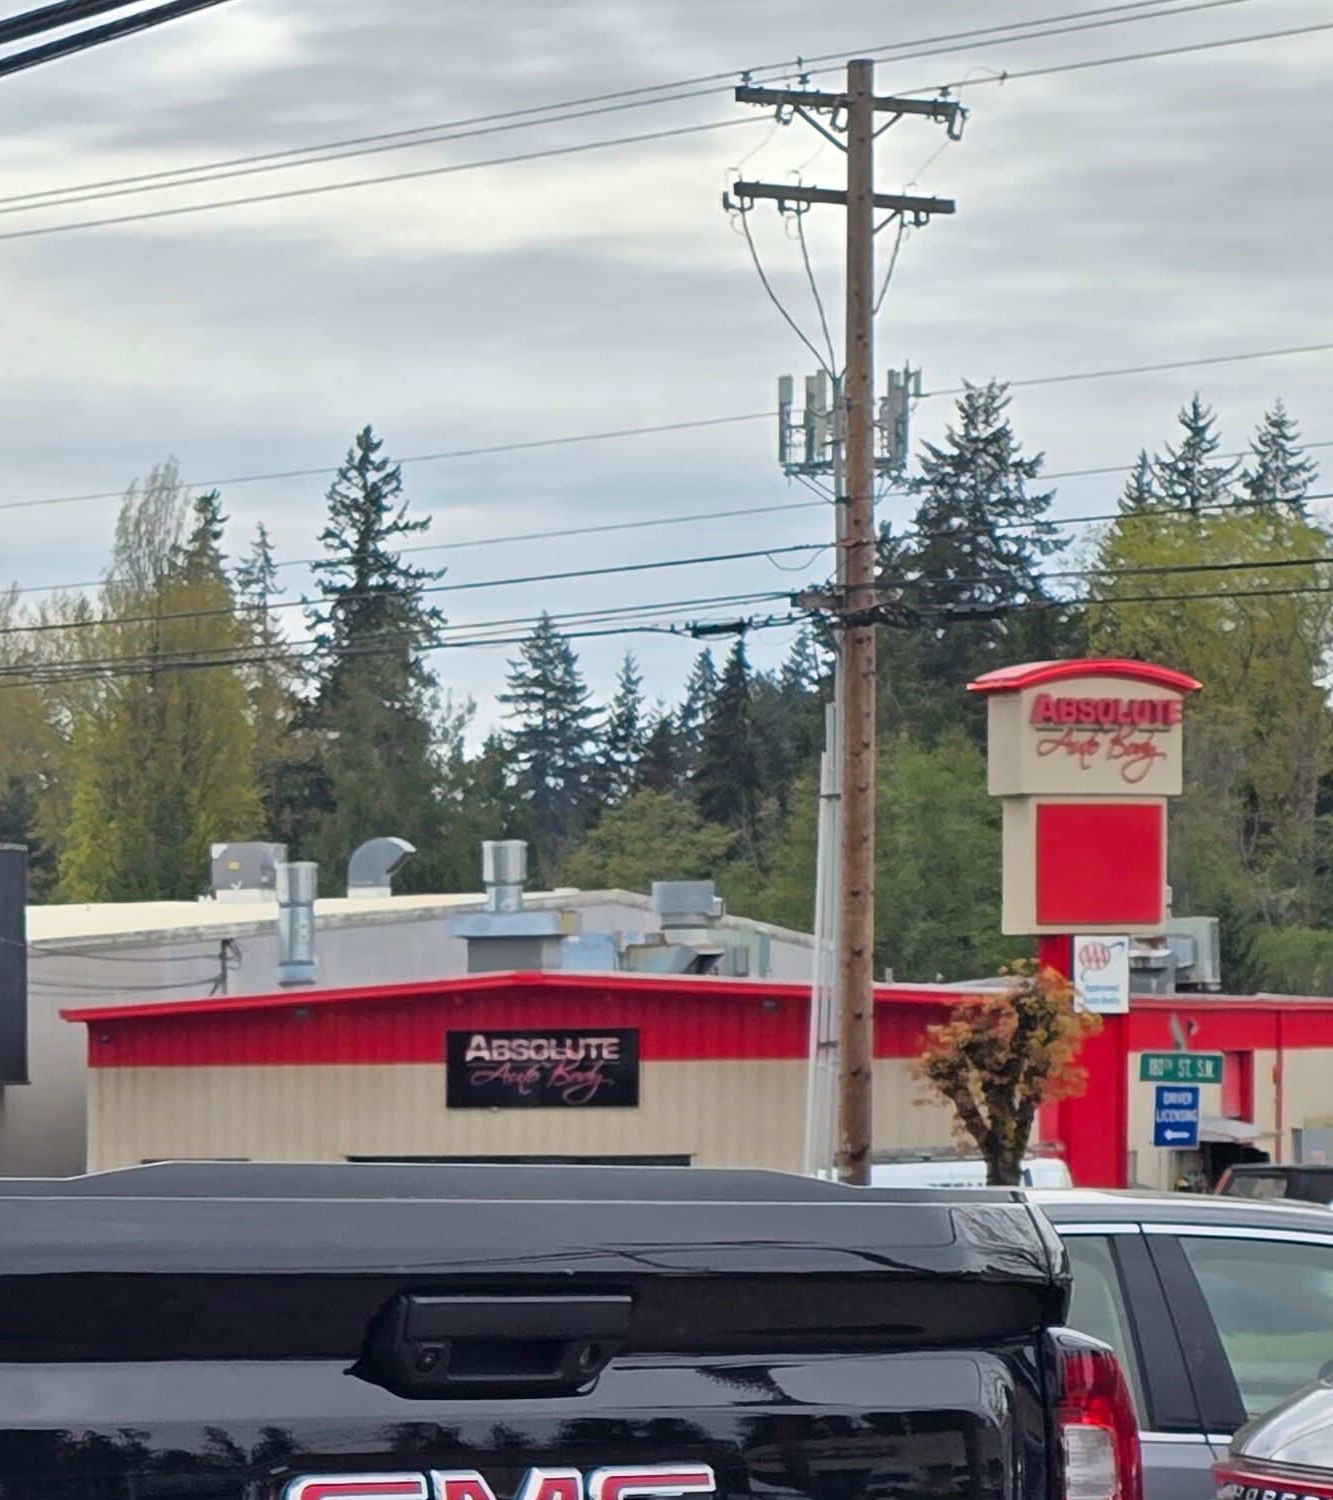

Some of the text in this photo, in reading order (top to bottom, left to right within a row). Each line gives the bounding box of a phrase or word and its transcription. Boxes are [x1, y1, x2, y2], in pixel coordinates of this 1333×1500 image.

[1030, 694, 1182, 726] ABSOLUTE
[465, 1034, 621, 1062] ABSOLUTE
[471, 1060, 615, 1105] Auto Body
[1162, 1090, 1193, 1105] DRIVER
